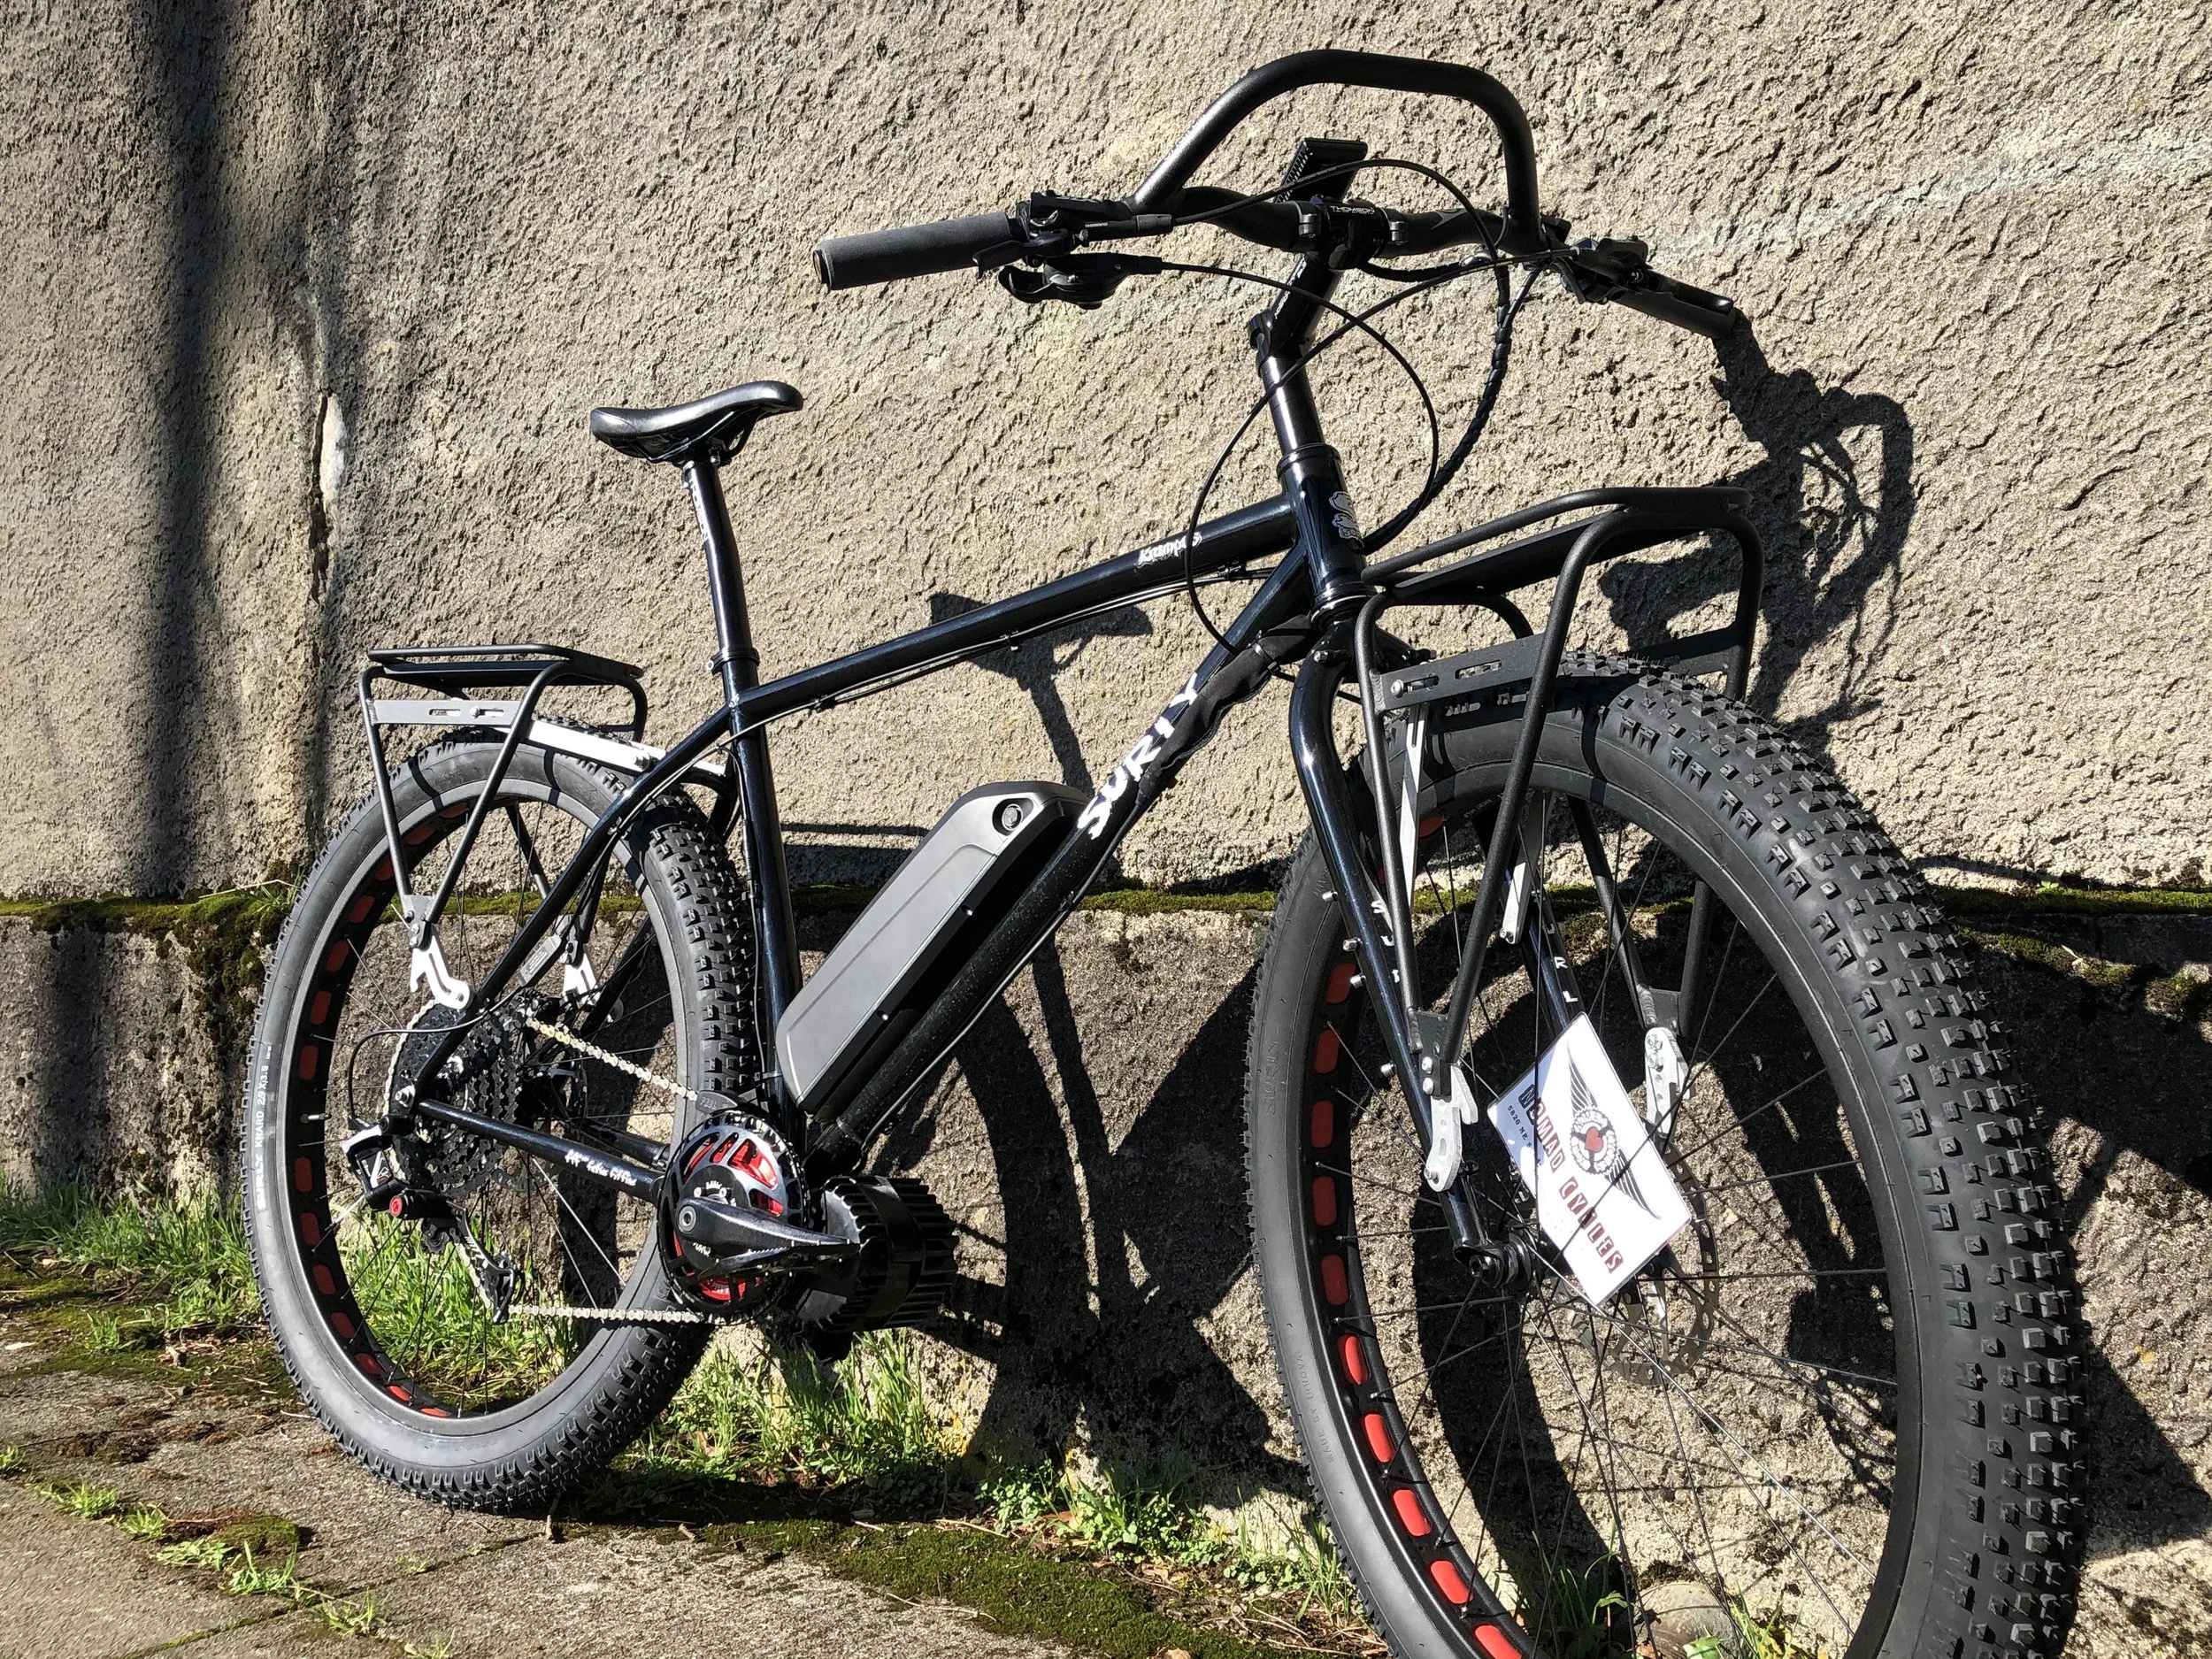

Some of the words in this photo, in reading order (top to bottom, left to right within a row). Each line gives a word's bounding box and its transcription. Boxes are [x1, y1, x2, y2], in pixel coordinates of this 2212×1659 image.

[1330, 205, 1376, 214] THOMSON
[1077, 672, 1198, 841] SURLY
[254, 1110, 265, 1148] KNARD
[1507, 1104, 1521, 1125] 5820
[1518, 1126, 1529, 1141] NE
[1518, 1084, 1566, 1174] NOMAD
